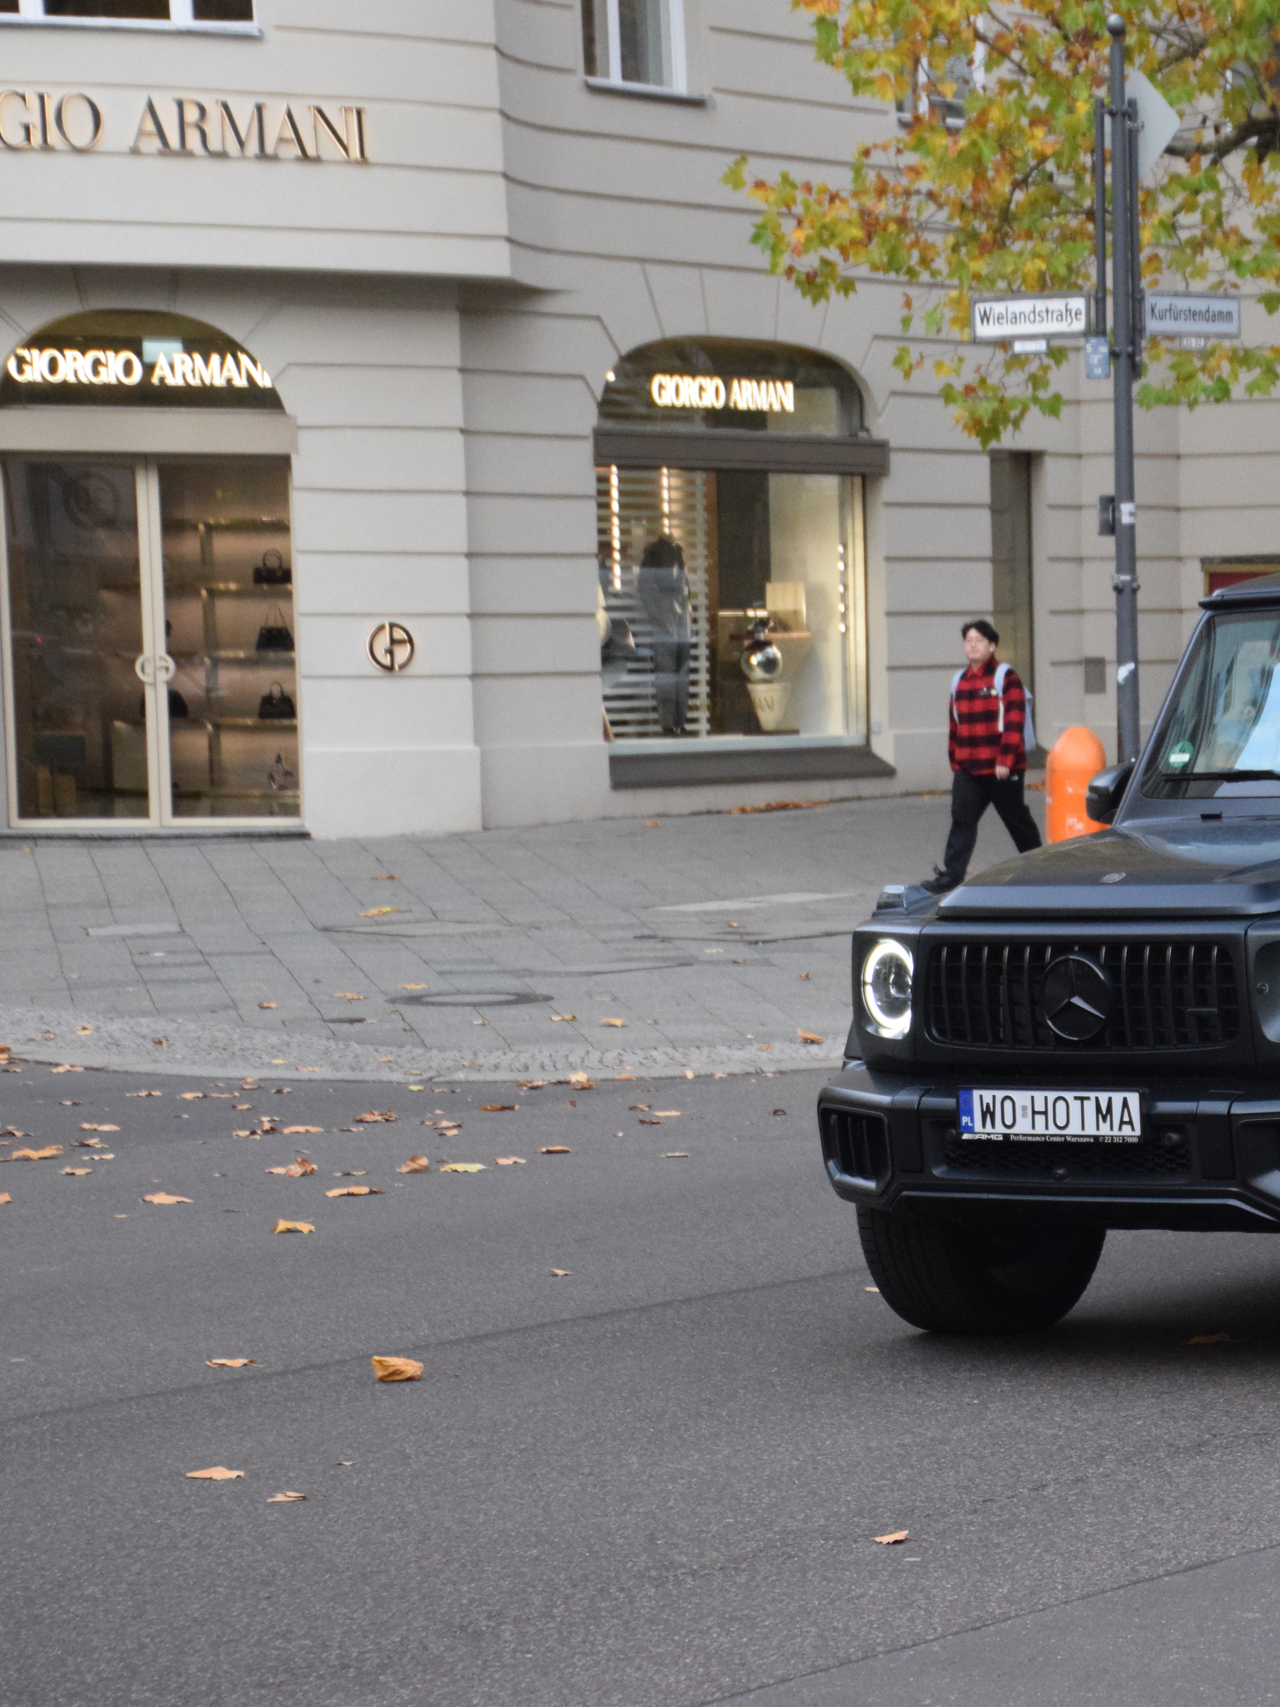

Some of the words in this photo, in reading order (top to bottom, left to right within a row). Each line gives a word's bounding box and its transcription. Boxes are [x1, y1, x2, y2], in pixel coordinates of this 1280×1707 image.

[130, 94, 369, 163] ARMANI
[977, 301, 1083, 327] Wielandstraße
[1150, 297, 1234, 324] Kurfürstendamm
[7, 347, 143, 386] GIORGIO
[651, 373, 726, 410] GIORGIO
[729, 377, 795, 413] ARMANI
[962, 1116, 973, 1126] PL
[979, 1094, 1017, 1130] WO
[1030, 1095, 1136, 1132] HOTMA
[1010, 1134, 1045, 1142] Performance
[1124, 1136, 1139, 1144] 7000
